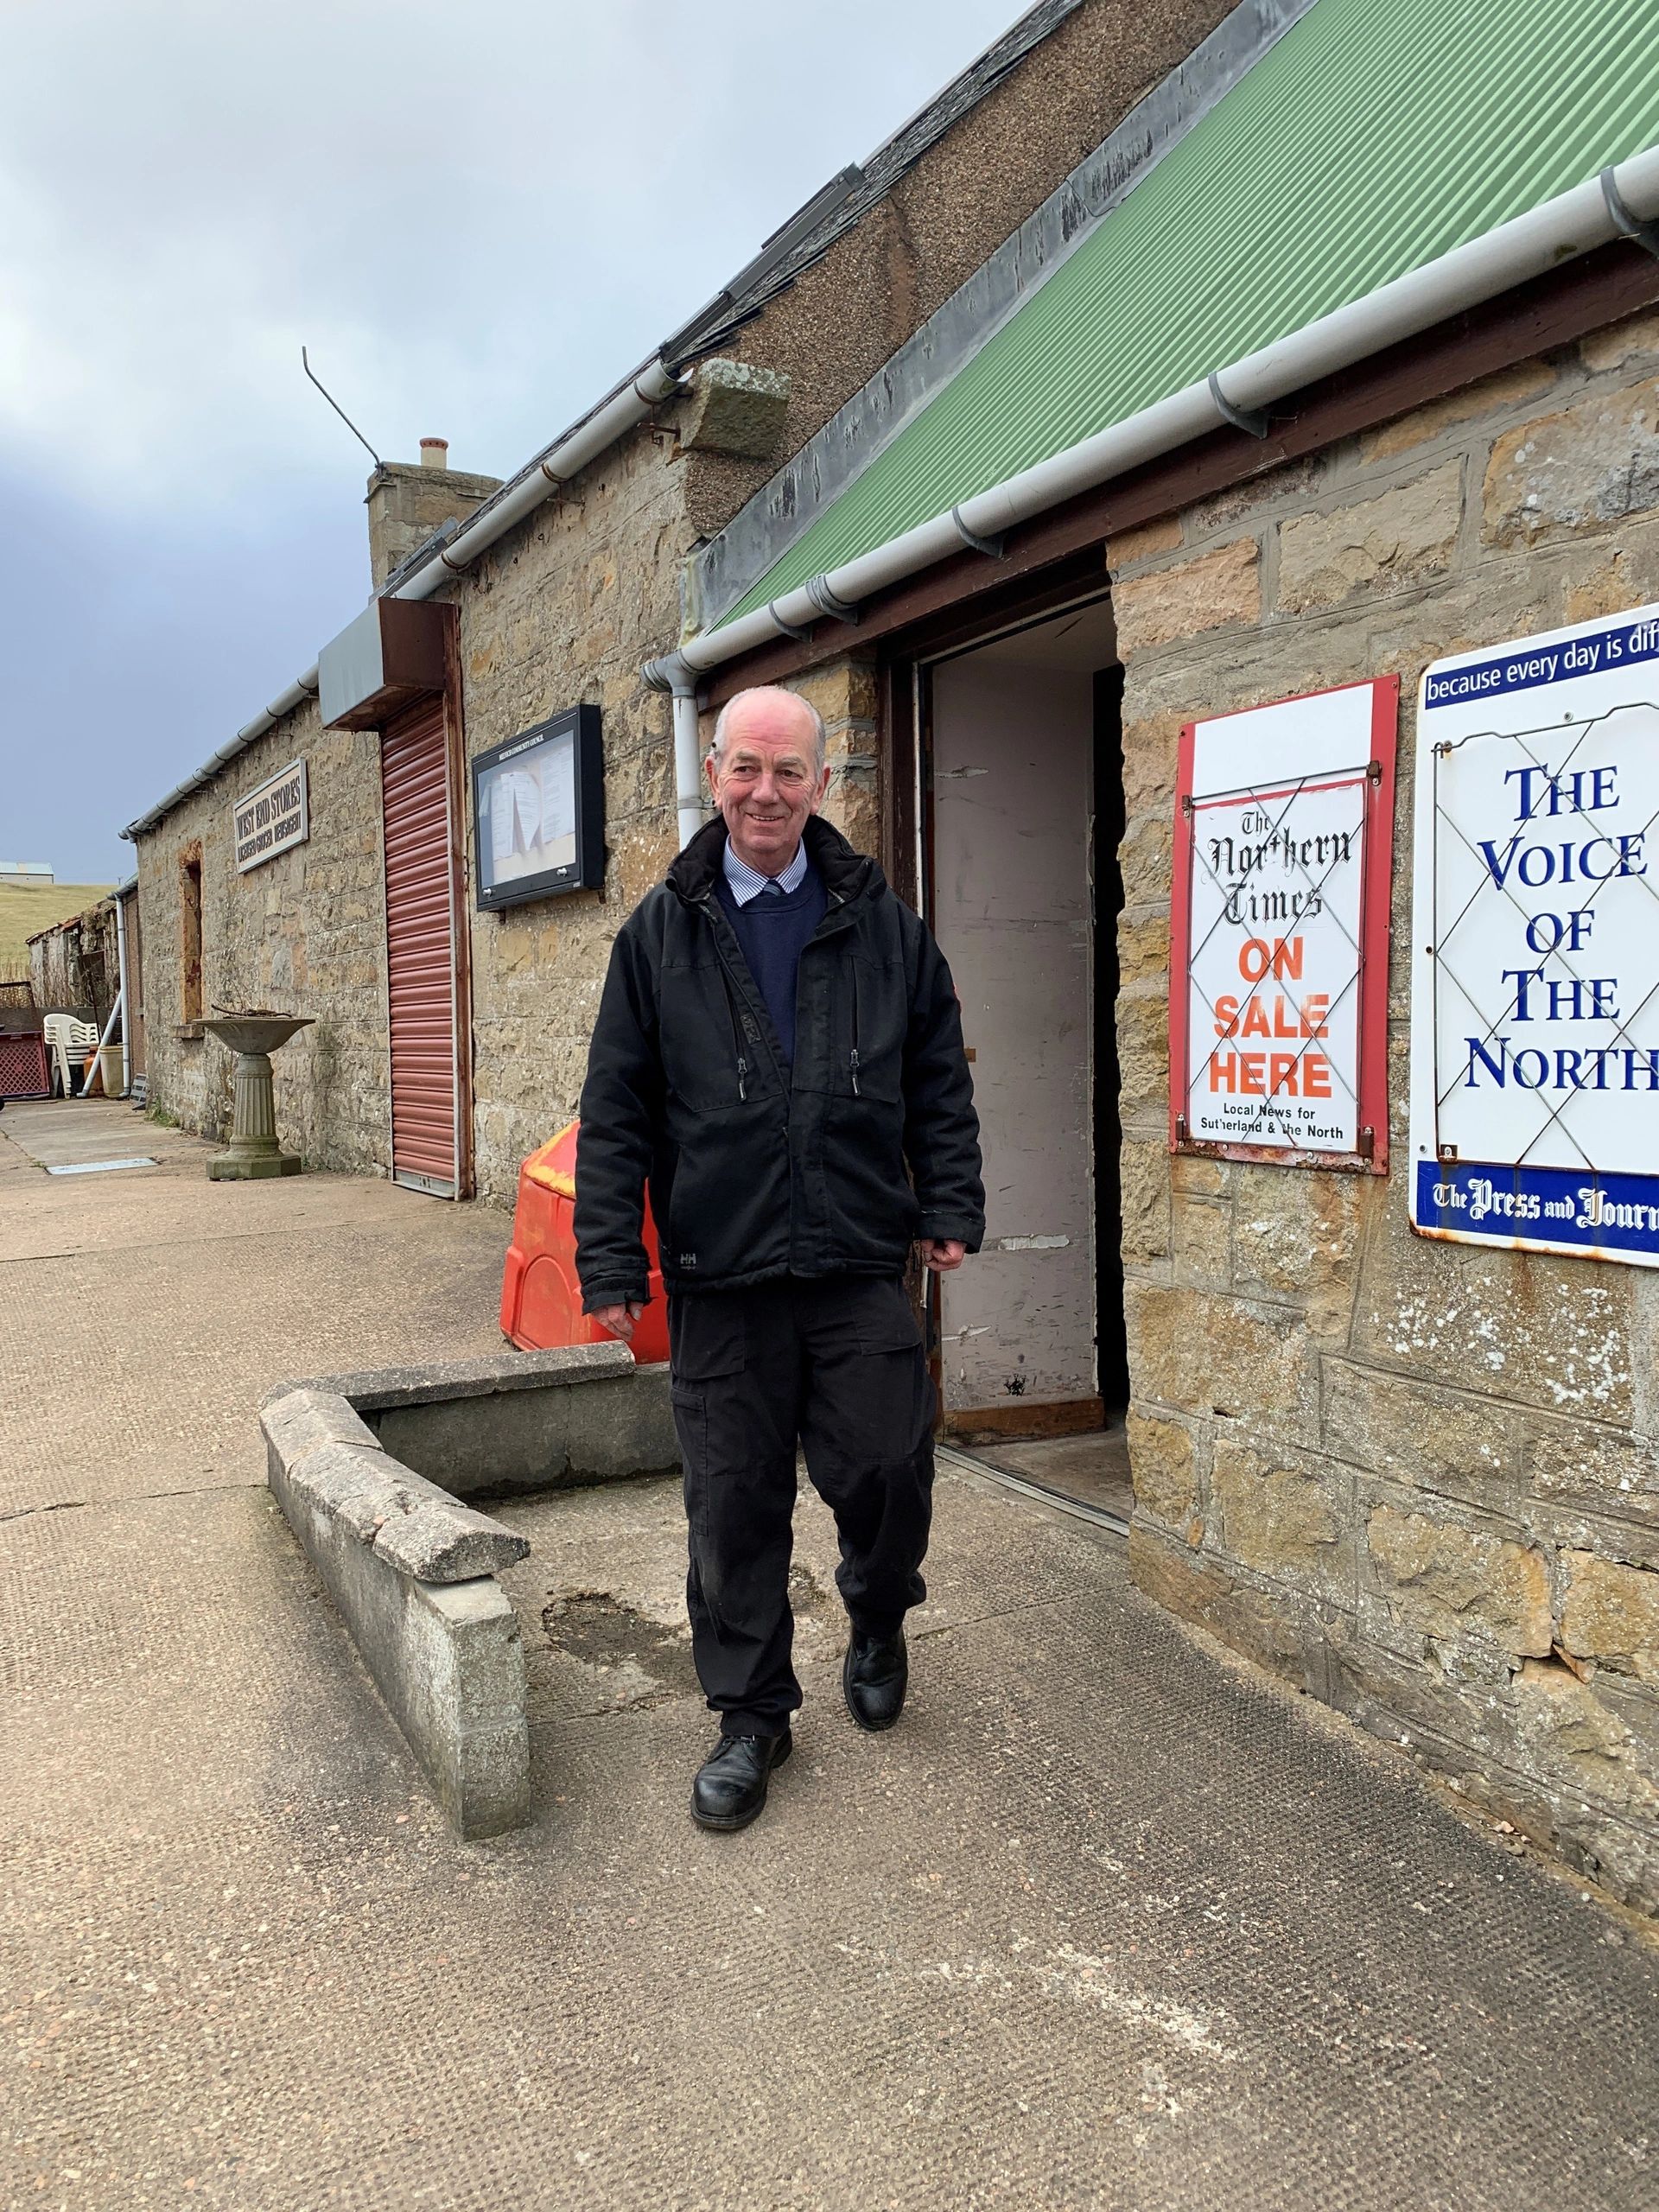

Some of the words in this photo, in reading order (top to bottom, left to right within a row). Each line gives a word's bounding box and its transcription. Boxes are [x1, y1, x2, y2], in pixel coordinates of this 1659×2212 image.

[1427, 668, 1501, 701] because
[1506, 654, 1558, 680] every
[1564, 643, 1600, 671] day
[1606, 633, 1623, 659] is
[238, 806, 255, 841] WEST
[255, 798, 270, 830] END
[271, 775, 301, 820] STORES
[1503, 762, 1620, 822] THE
[1240, 811, 1270, 836] The
[1205, 826, 1353, 879] Northern
[1477, 832, 1648, 891] VOICE
[1224, 882, 1323, 926] Times
[1526, 910, 1595, 954] OF
[1238, 937, 1304, 982] ON
[1213, 994, 1329, 1039] SALE
[1501, 968, 1620, 1021] THE
[1209, 1052, 1332, 1098] HERE
[1464, 1037, 1659, 1090] NORTH
[1201, 1117, 1262, 1133] Sutherland
[1268, 1122, 1275, 1134] &
[1282, 1125, 1301, 1136] the
[1307, 1125, 1344, 1140] North
[1224, 1103, 1254, 1116] Local
[1259, 1105, 1292, 1119] News
[1298, 1108, 1316, 1120] for
[1433, 1183, 1468, 1209] The
[1468, 1178, 1541, 1220] Press
[1544, 1195, 1575, 1220] and
